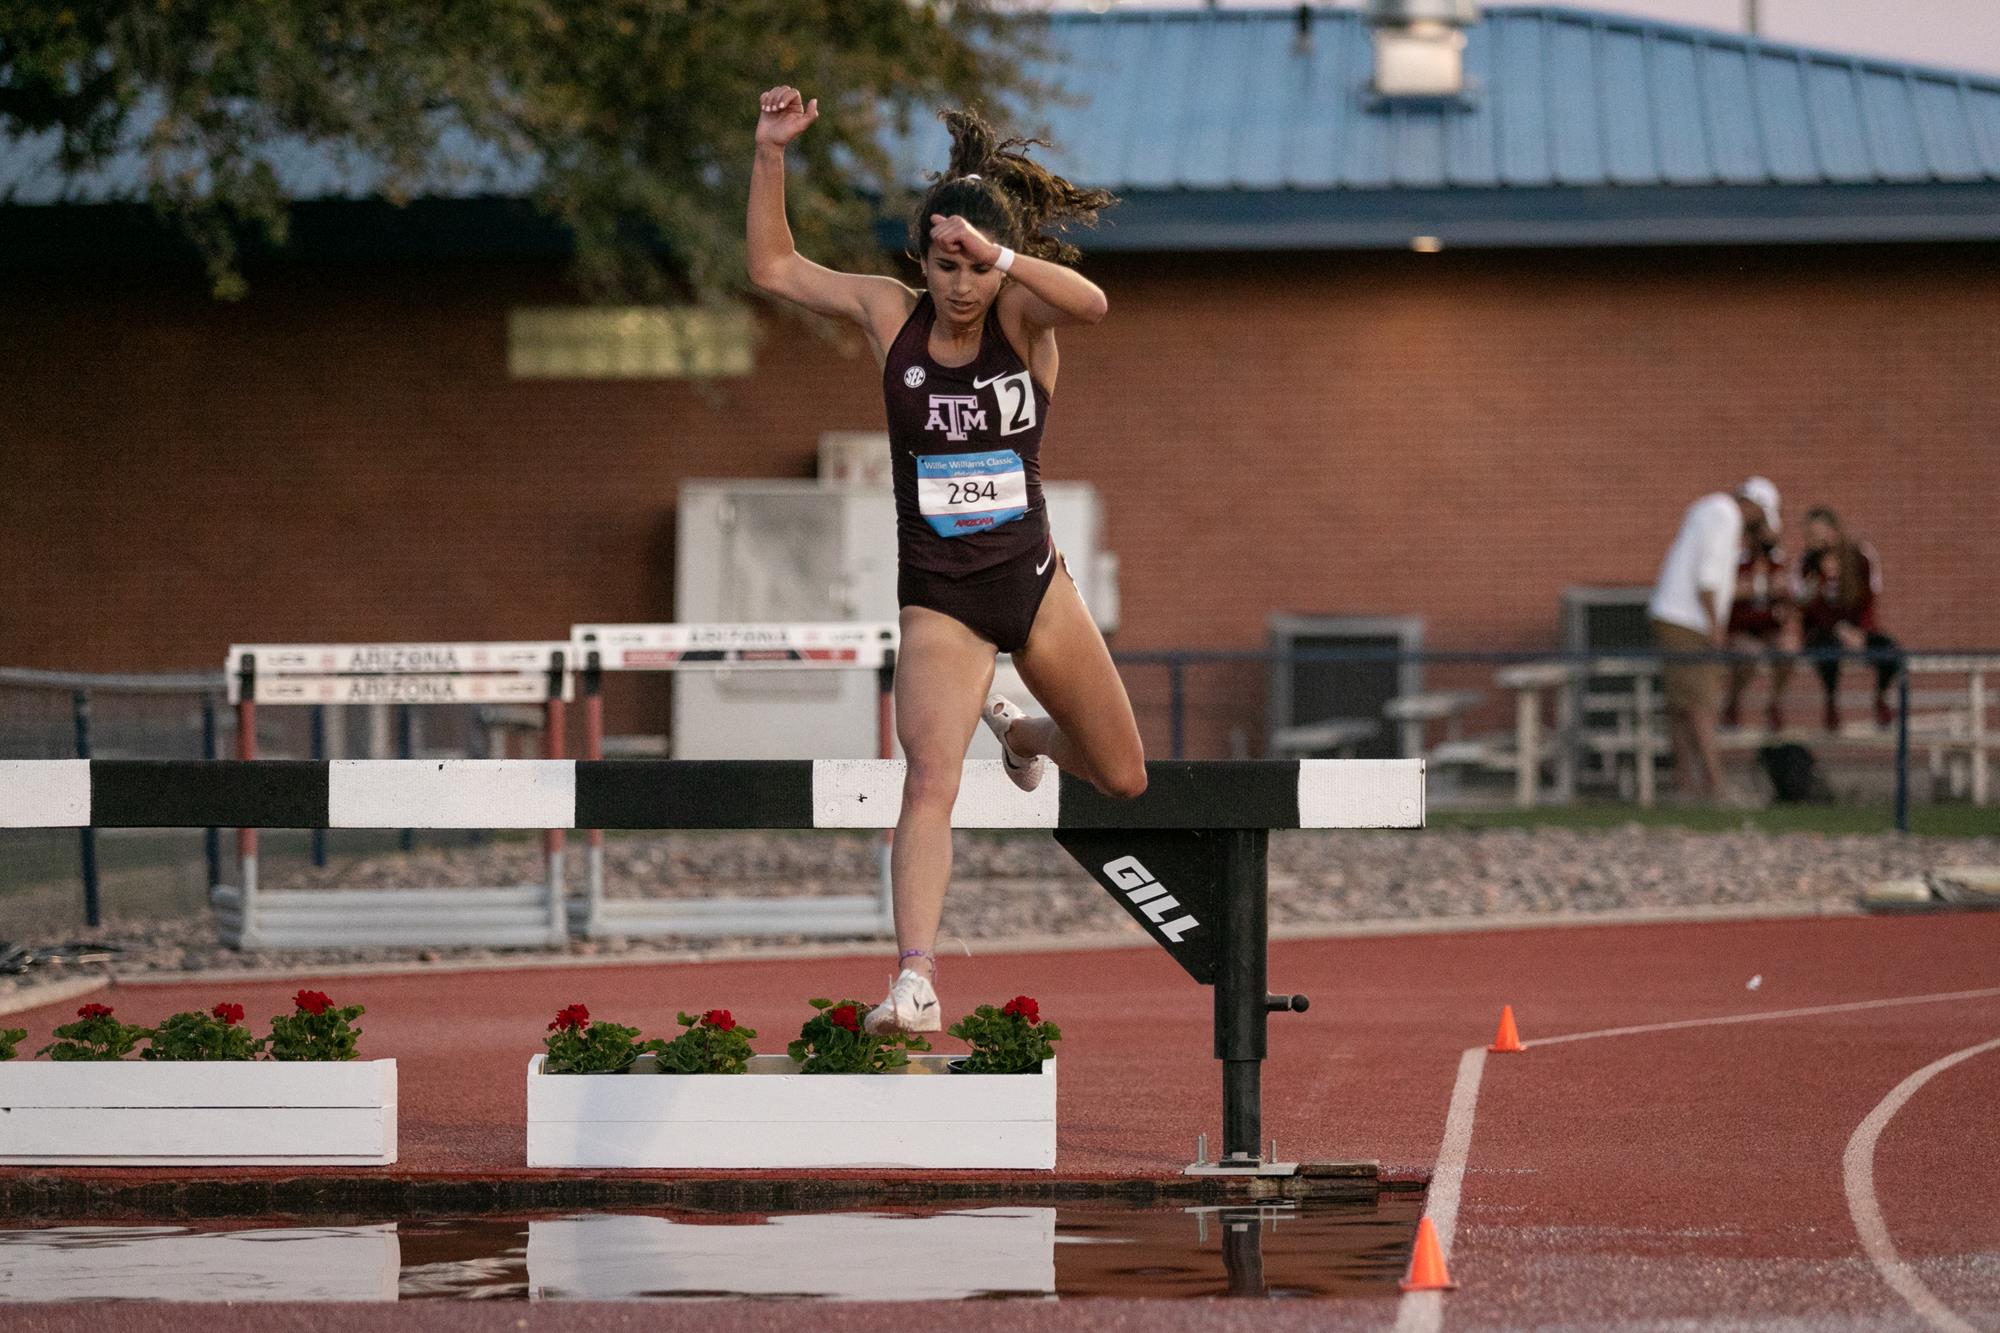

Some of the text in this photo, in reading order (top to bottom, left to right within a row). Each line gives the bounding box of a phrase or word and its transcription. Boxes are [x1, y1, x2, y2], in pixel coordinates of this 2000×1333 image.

[906, 368, 923, 385] SEC
[1005, 378, 1030, 431] 2
[924, 456, 1013, 470] Willie Williams Classic
[947, 480, 998, 505] 284
[349, 649, 458, 670] ARIZONA
[347, 680, 456, 701] ARIZONA
[1102, 855, 1200, 943] GILL
